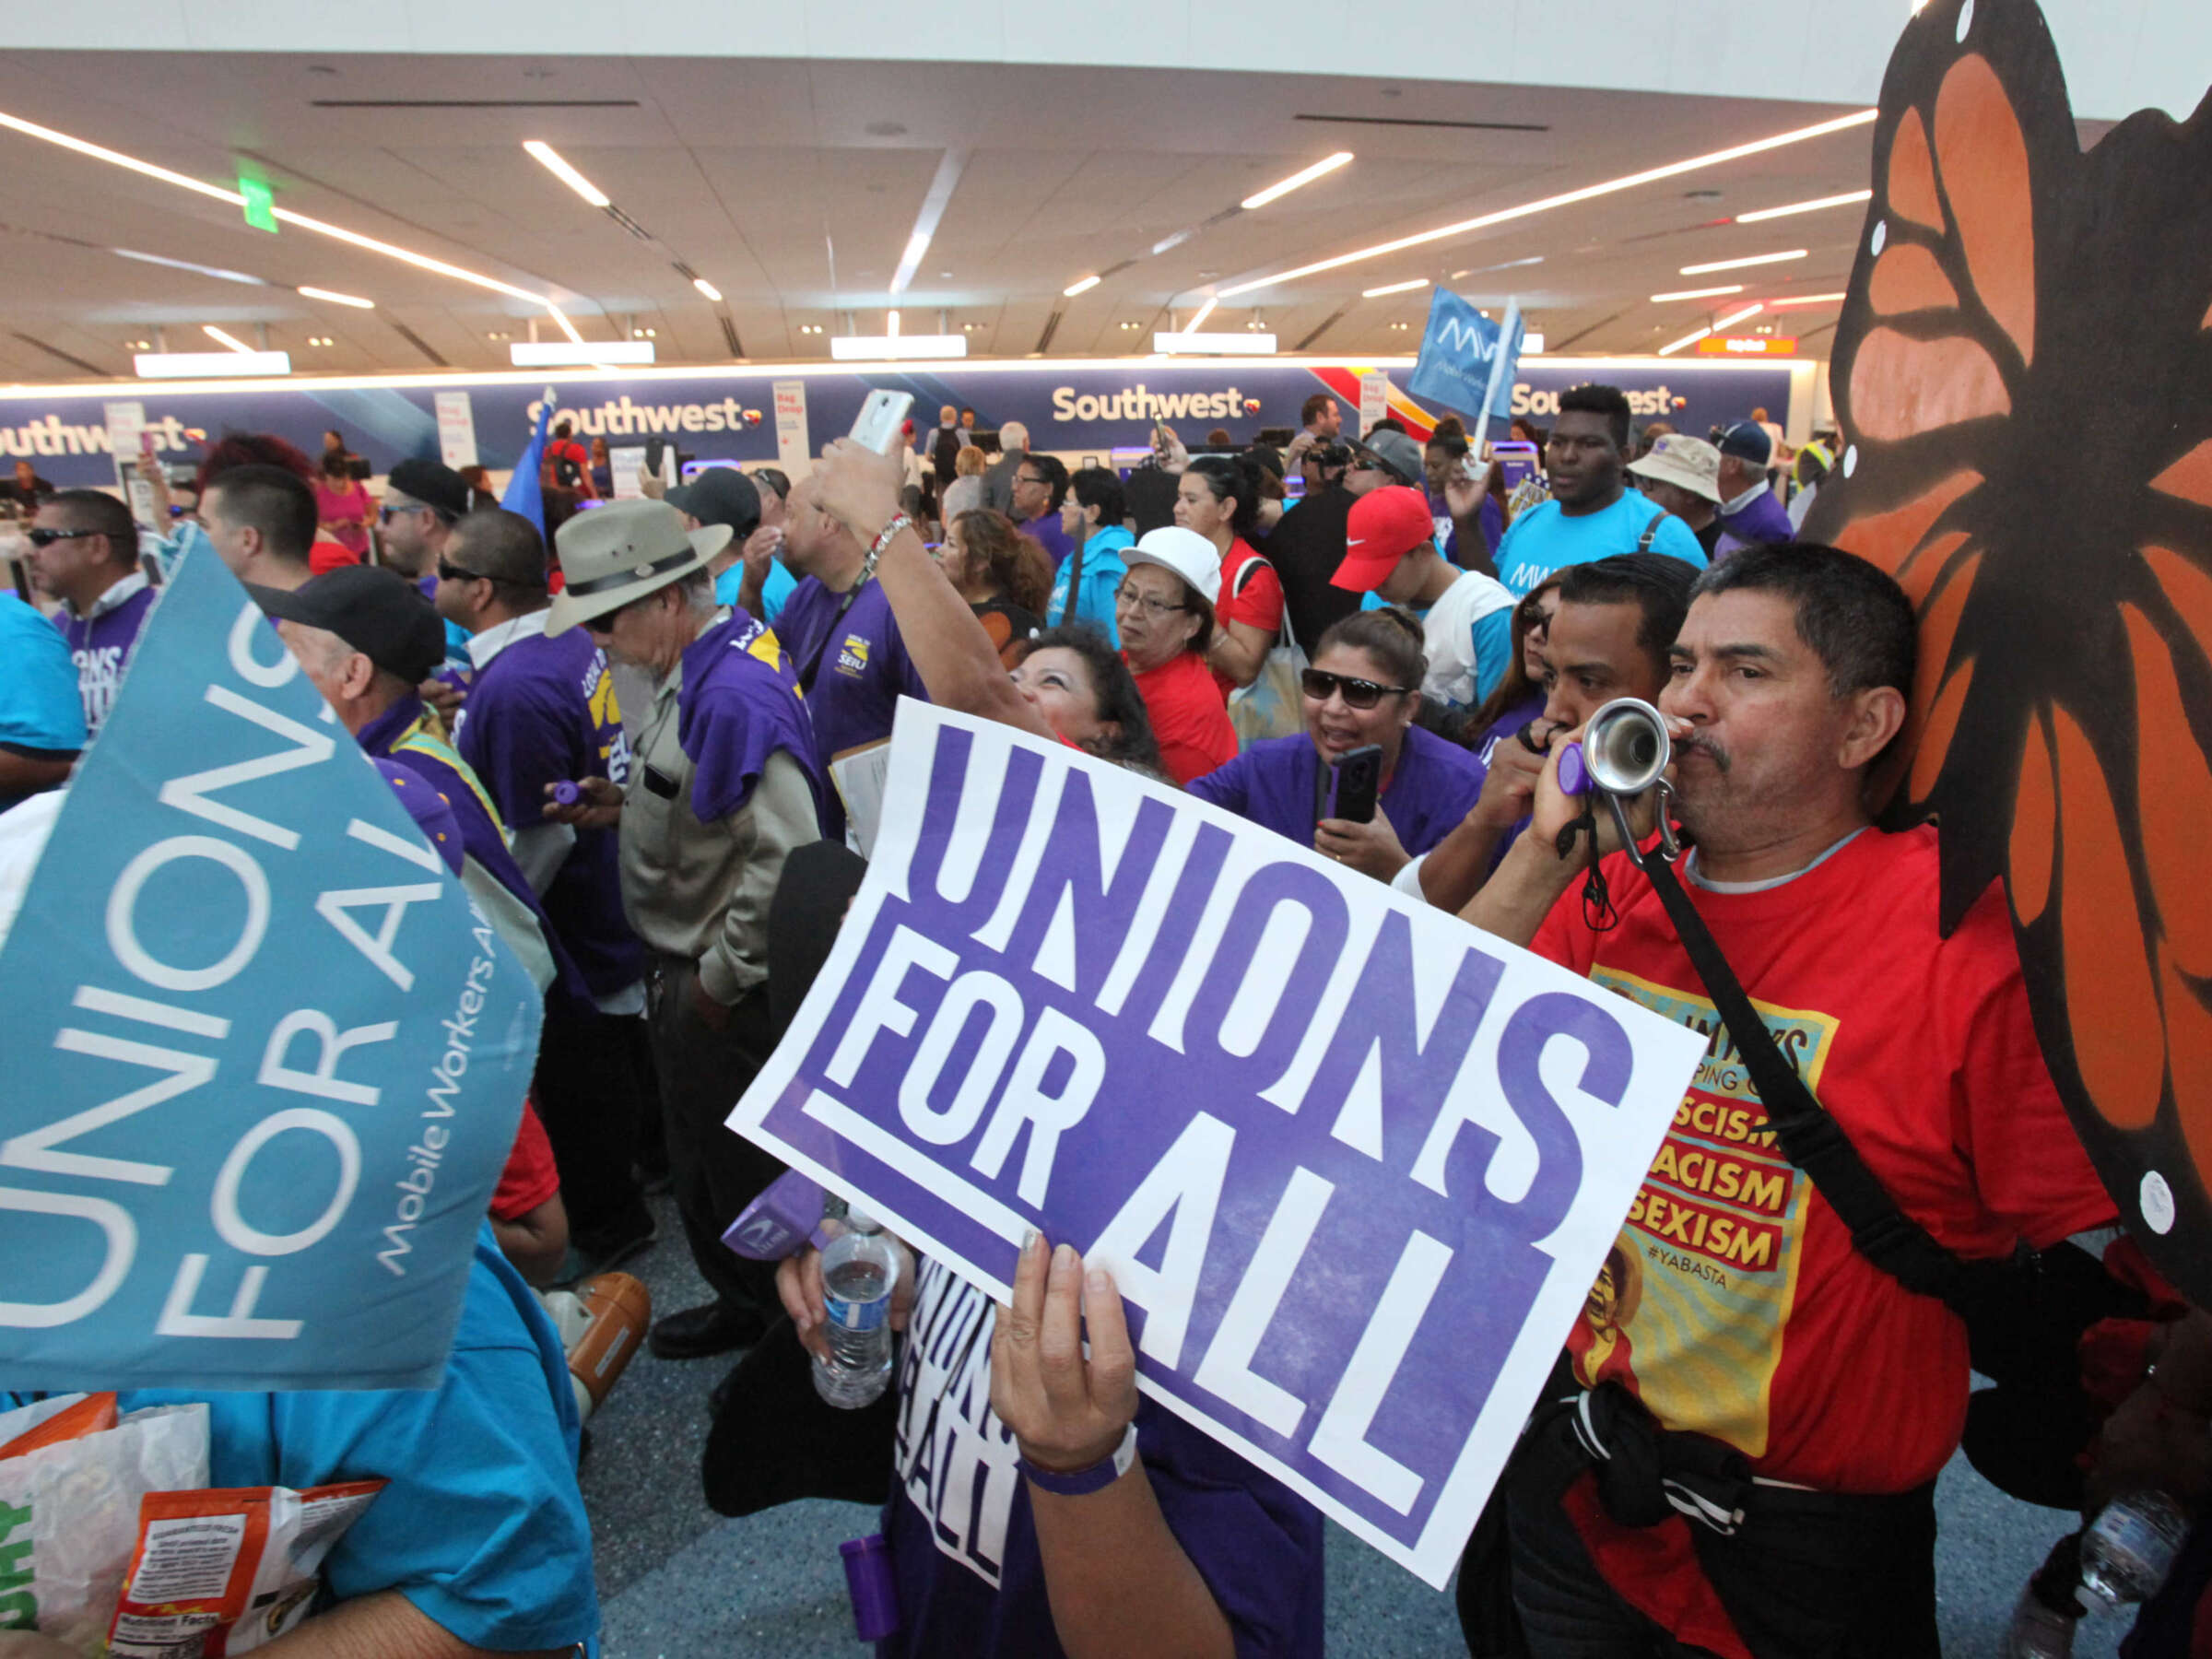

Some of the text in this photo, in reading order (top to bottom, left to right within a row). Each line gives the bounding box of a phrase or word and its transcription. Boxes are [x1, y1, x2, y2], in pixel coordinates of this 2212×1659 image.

[1053, 385, 1242, 421] Southwest
[0, 414, 187, 457] uthwst
[1510, 561, 1559, 590] MW
[838, 653, 867, 670] SEIU
[908, 724, 1635, 1240] UNIONS
[155, 1009, 398, 1339] FOR
[314, 793, 443, 993] AL
[1693, 1063, 1738, 1091] PING
[376, 1124, 450, 1277] Mobile
[420, 955, 494, 1119] Workers
[1650, 1144, 1786, 1212] ACISM
[826, 924, 1453, 1517] FOR ALL
[1628, 1189, 1772, 1267] SEXISM
[1647, 1245, 1728, 1289] #YABASTA
